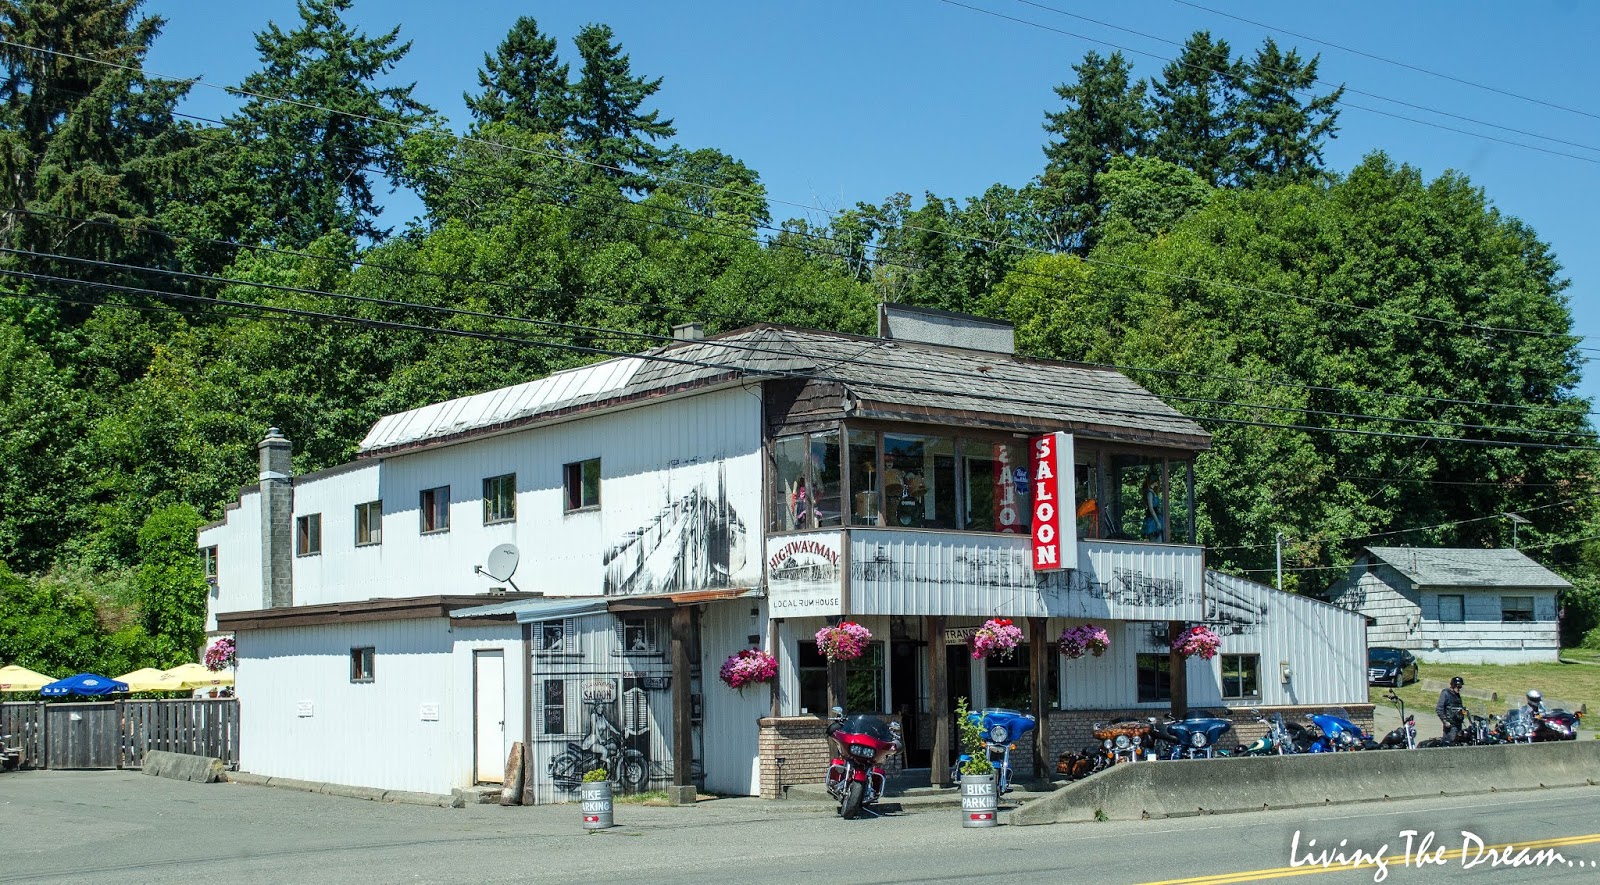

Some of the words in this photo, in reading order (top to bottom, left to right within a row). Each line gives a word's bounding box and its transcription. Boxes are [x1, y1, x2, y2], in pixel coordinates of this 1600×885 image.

[1034, 438, 1057, 565] SALOON
[769, 540, 839, 572] HIGHWAYMAN
[774, 600, 797, 609] LOCAL
[816, 598, 839, 606] HOUSE
[582, 789, 602, 800] BIKE
[967, 783, 992, 795] BIKE
[962, 796, 997, 809] PARKIN
